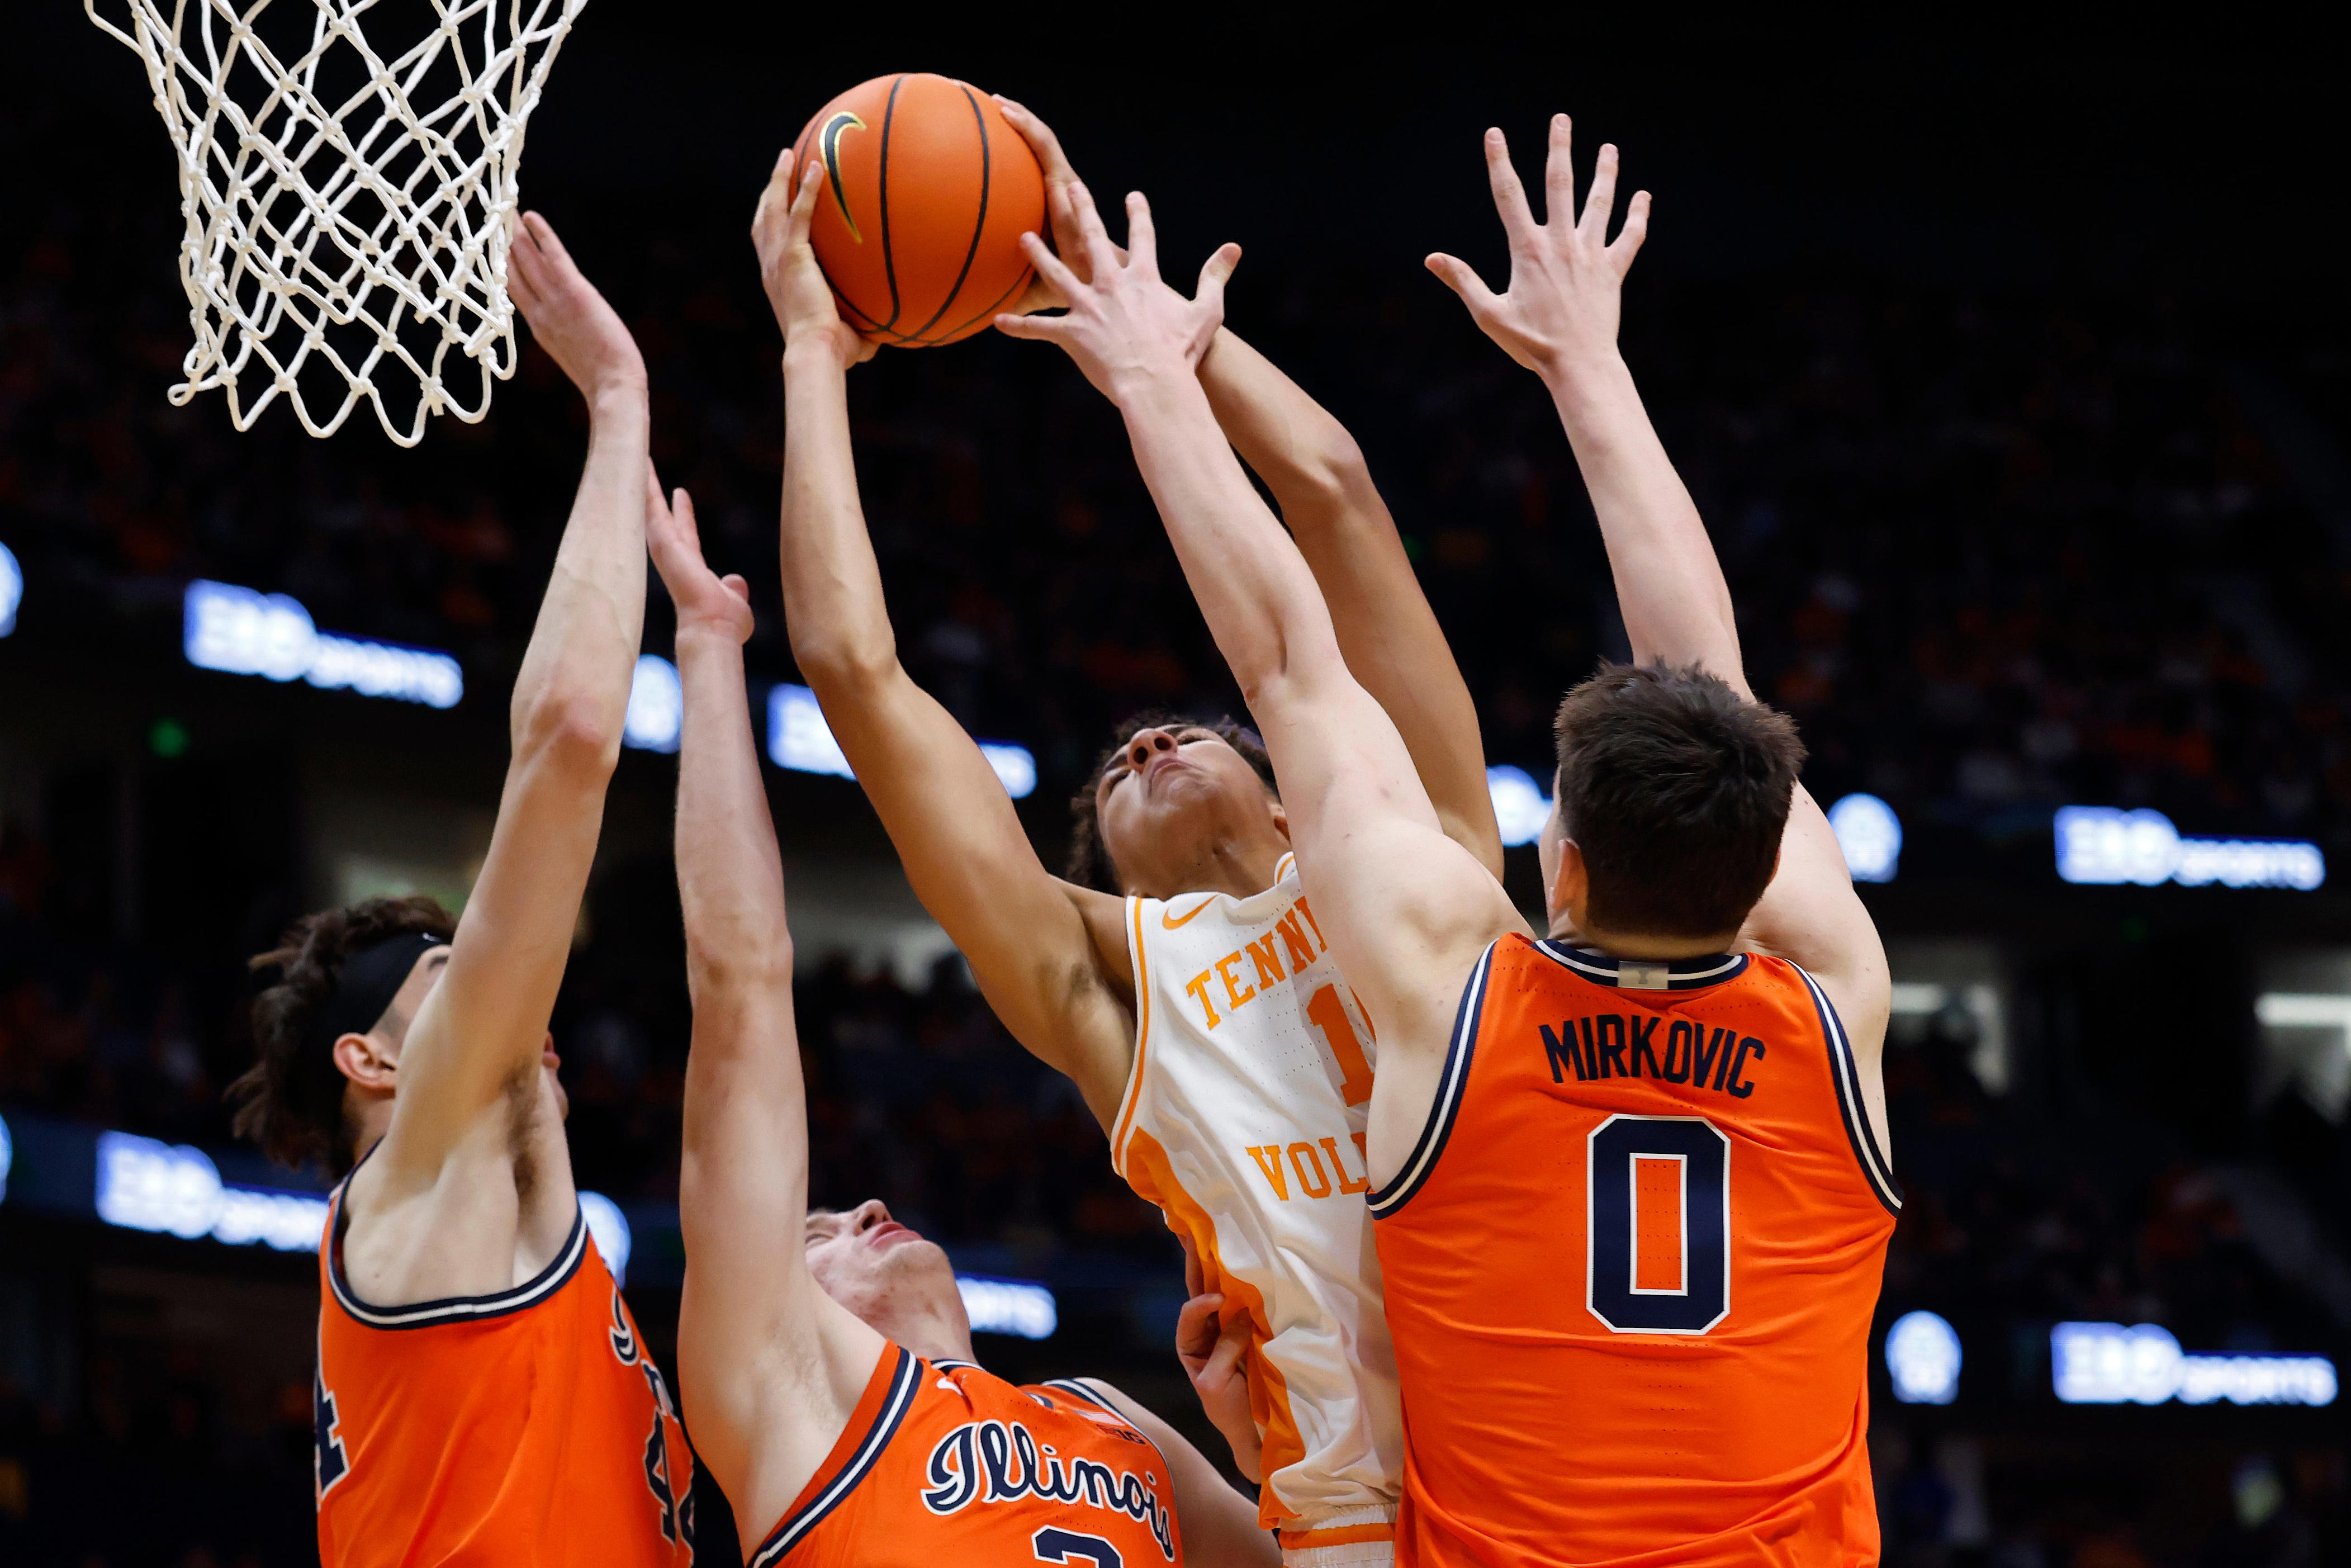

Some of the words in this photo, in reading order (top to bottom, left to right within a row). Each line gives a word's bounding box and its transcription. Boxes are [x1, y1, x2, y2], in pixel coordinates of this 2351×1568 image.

[1306, 983, 1376, 1107] 1
[1539, 1014, 1765, 1099] MIRKOVIC
[1586, 1113, 1731, 1335] 0
[920, 1419, 1175, 1562] Illinois
